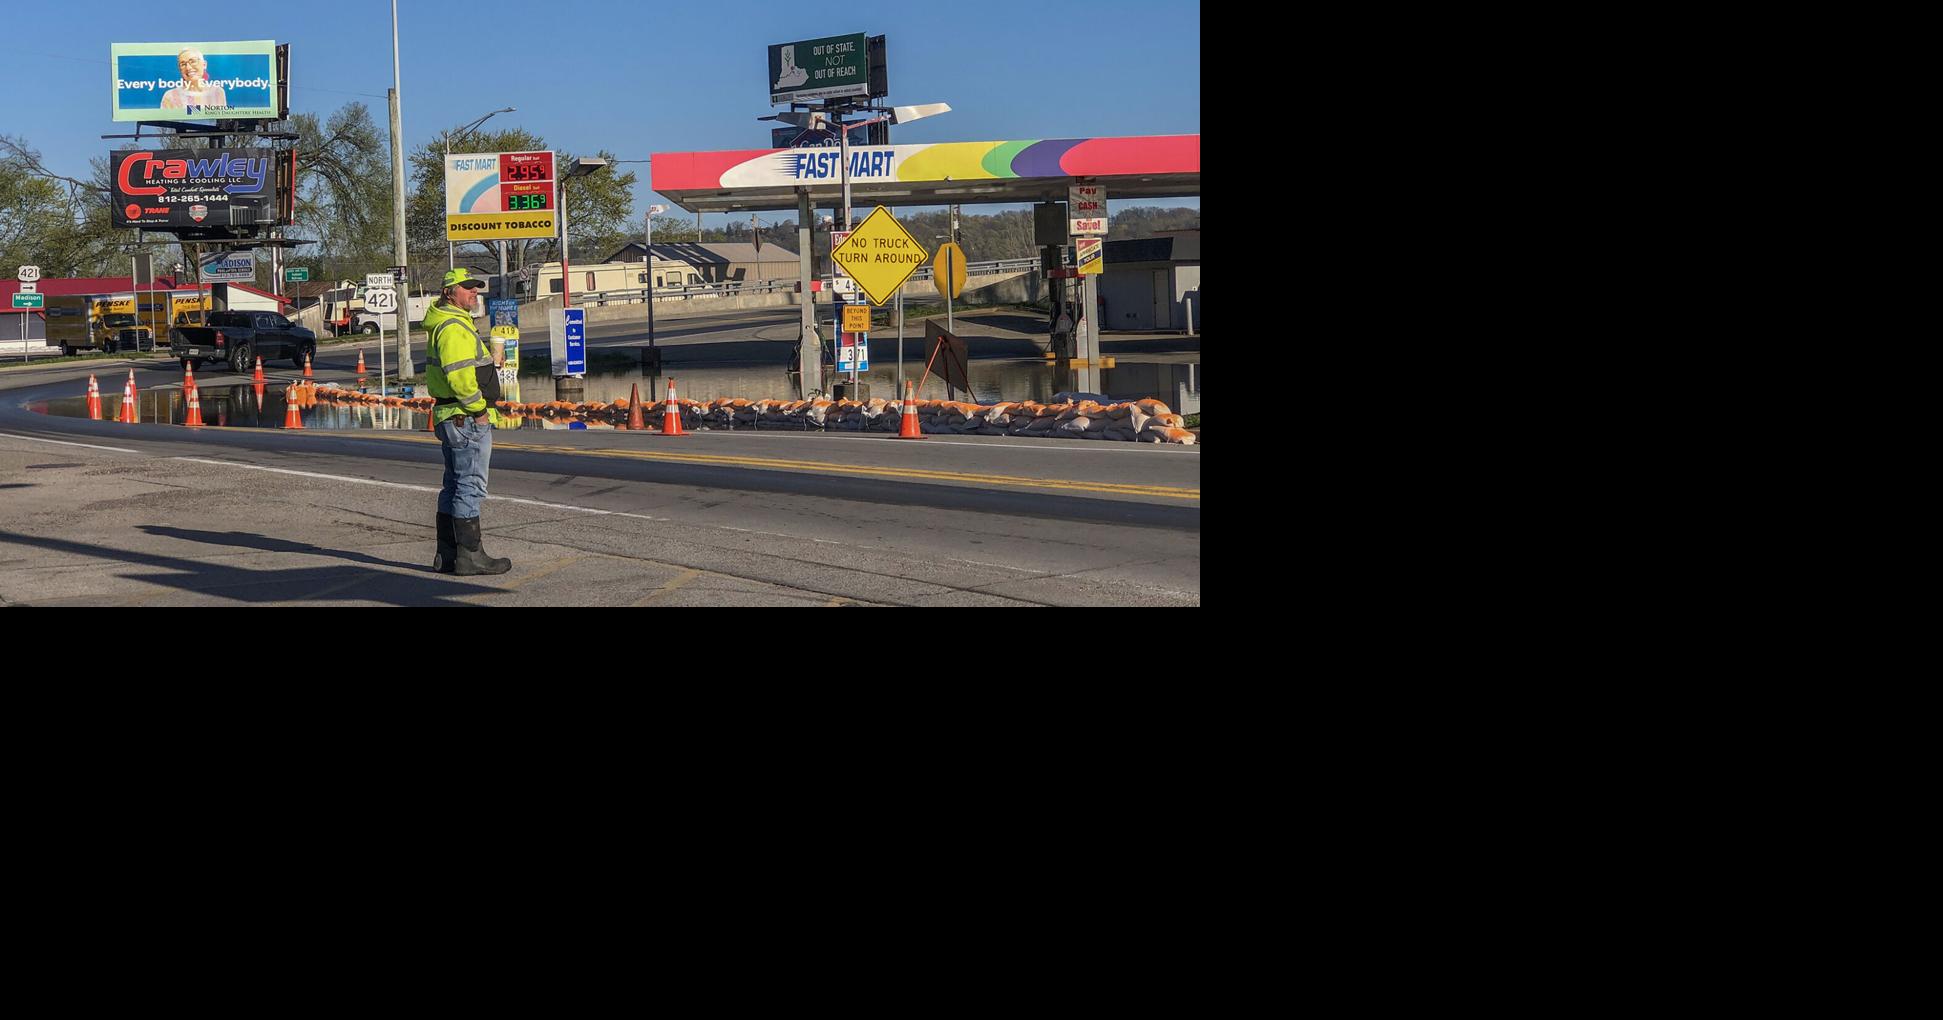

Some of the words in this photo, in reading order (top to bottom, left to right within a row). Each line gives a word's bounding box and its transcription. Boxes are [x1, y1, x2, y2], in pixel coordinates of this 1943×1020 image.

[813, 45, 825, 56] OUT
[826, 44, 835, 54] OF
[825, 54, 846, 66] NOT
[814, 69, 826, 79] OUT
[827, 67, 835, 78] OF
[836, 65, 857, 77] REACH
[117, 79, 155, 91] Every
[158, 78, 194, 90] body.
[199, 77, 271, 89] Everybody.
[455, 159, 474, 171] FAST
[474, 158, 496, 171] MART
[796, 151, 840, 179] FAST
[118, 151, 268, 196] Crawley
[1079, 187, 1097, 195] Pay
[158, 194, 229, 203] 812-265-1444
[1078, 202, 1098, 210] CASH
[450, 222, 502, 231] DISCOUNT
[504, 220, 552, 229] TOBACCO
[1076, 220, 1101, 231] Save!
[851, 238, 867, 248] NO
[873, 238, 909, 249] TRUCK
[839, 252, 869, 263] TURN
[874, 252, 922, 264] AROUND
[1083, 253, 1096, 263] YOUR
[20, 268, 38, 278] 421
[368, 276, 392, 284] NORTH
[95, 300, 130, 308] PENSKE
[368, 293, 394, 308] 421
